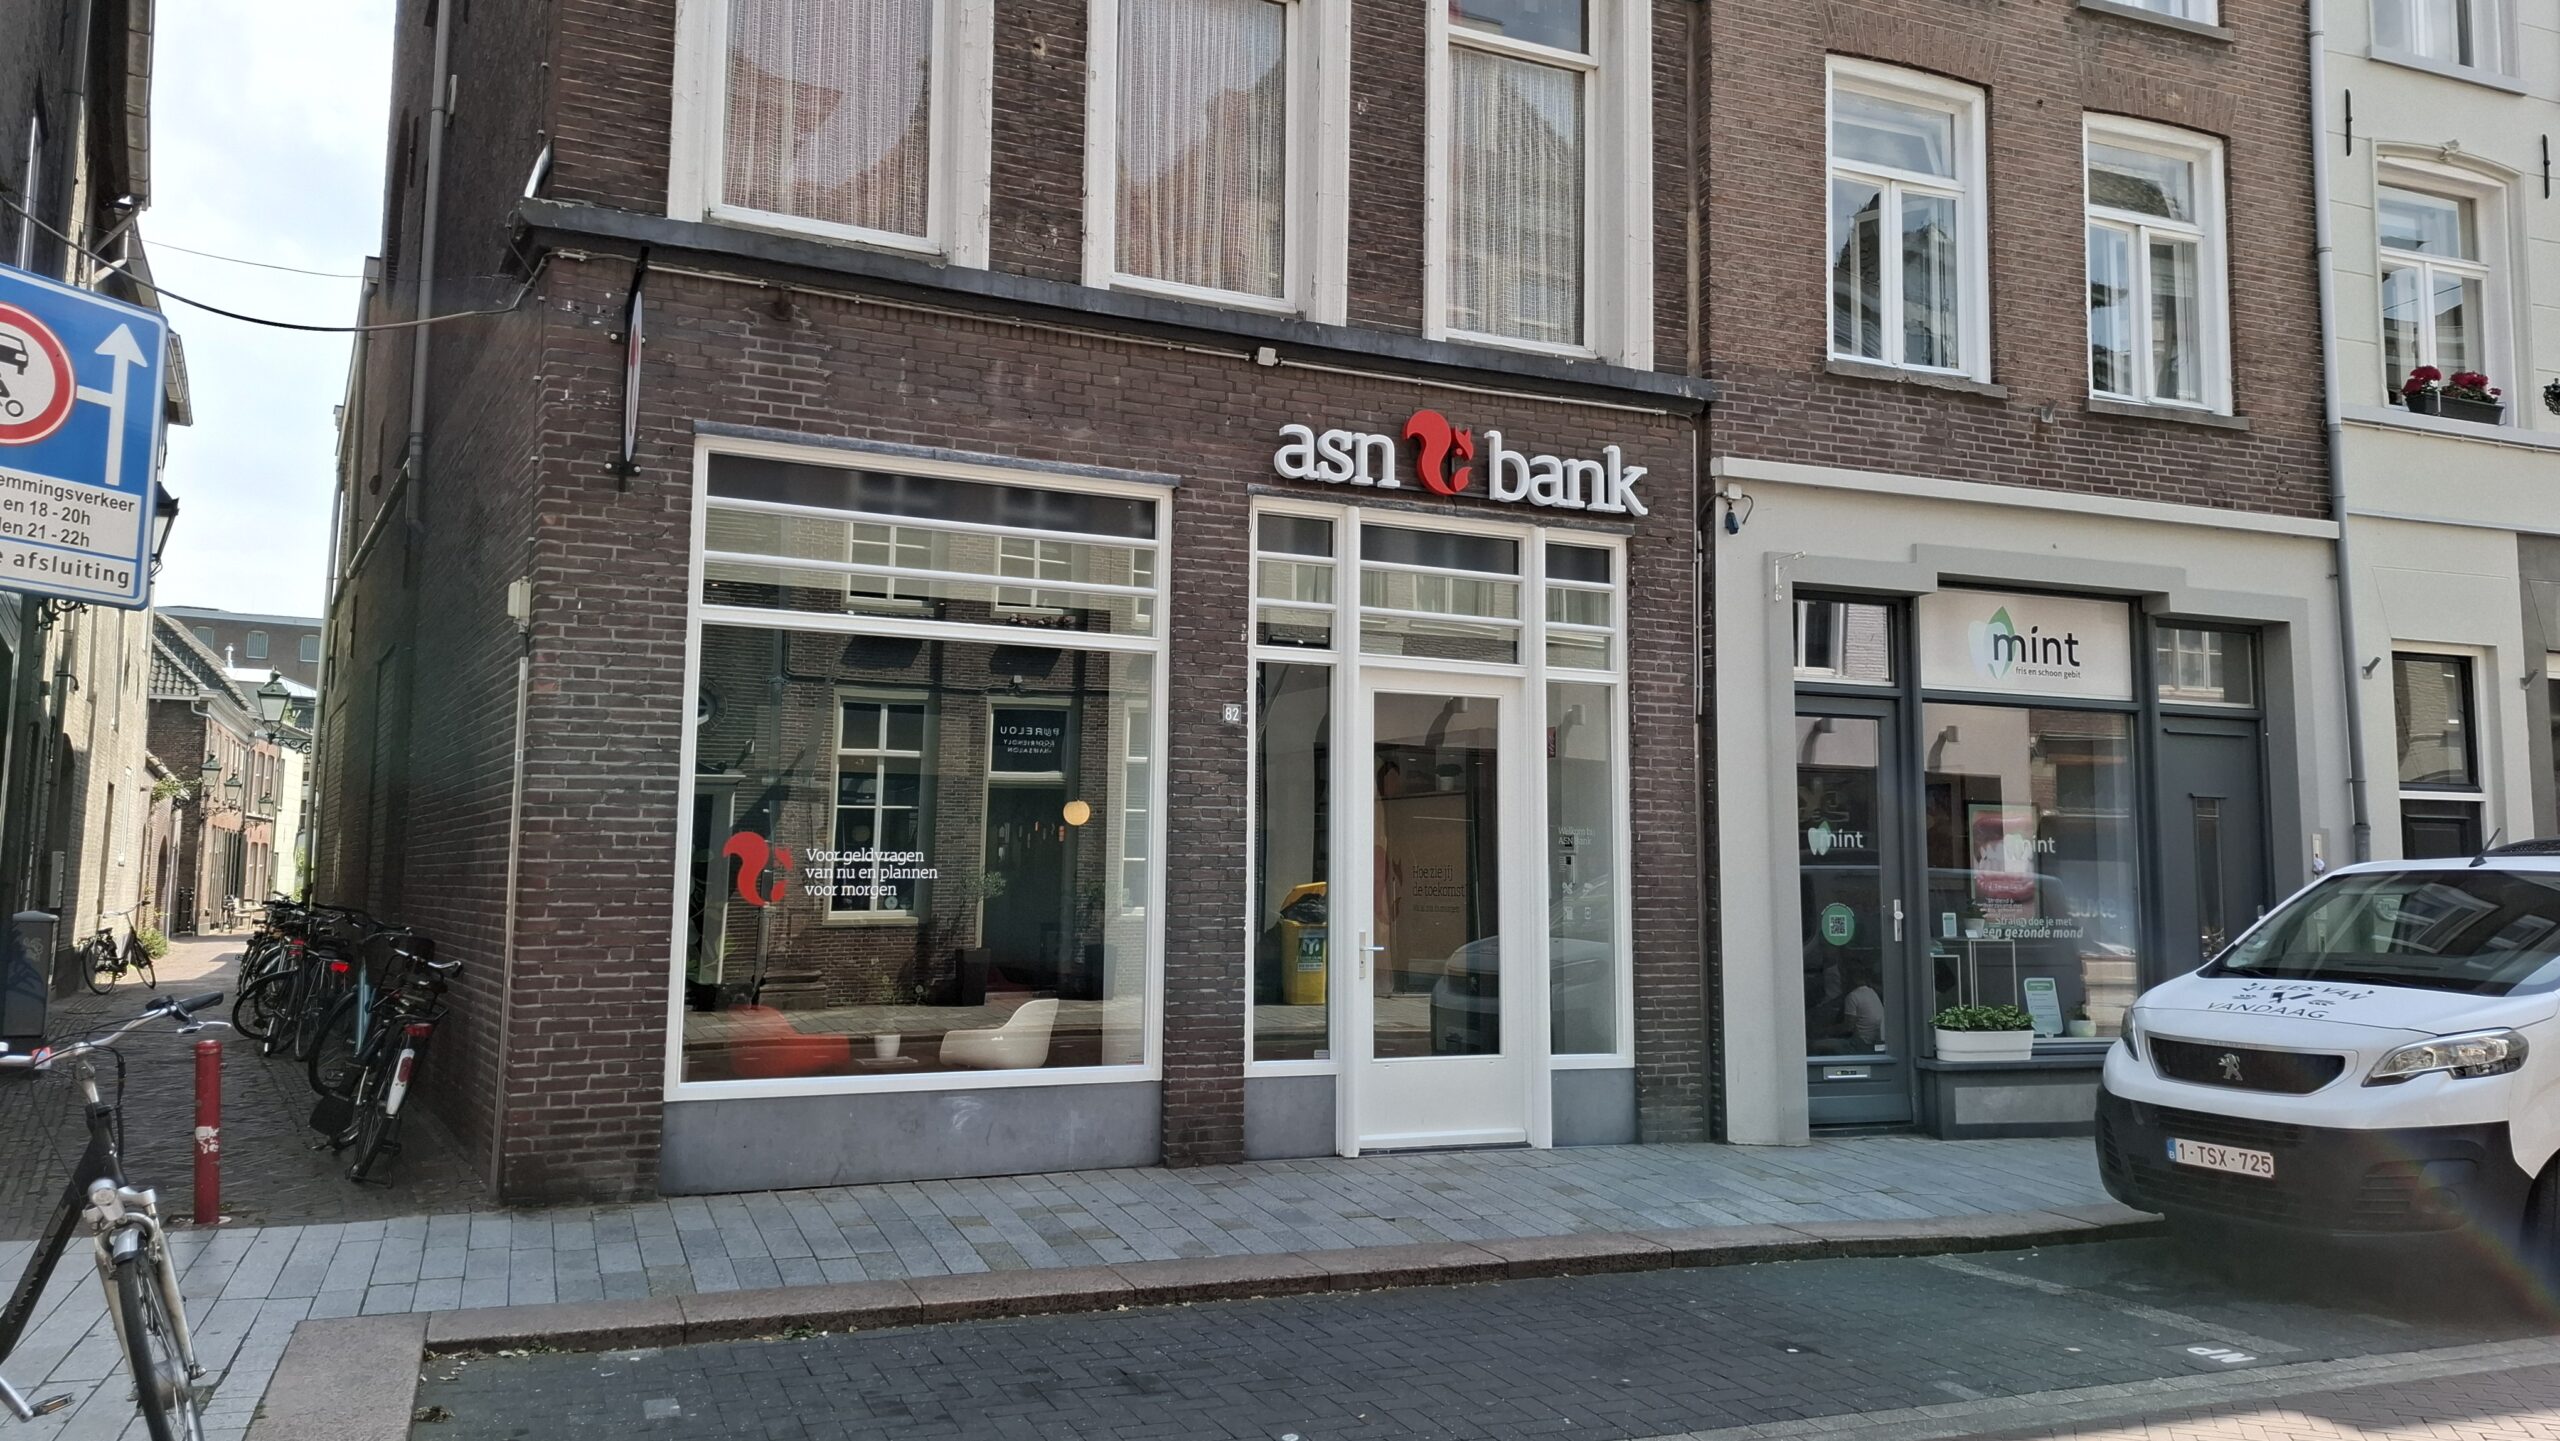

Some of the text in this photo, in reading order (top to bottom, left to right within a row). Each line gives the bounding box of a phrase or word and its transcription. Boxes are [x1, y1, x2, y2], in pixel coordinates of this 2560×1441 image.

[1273, 423, 1649, 517] asn bank
[3, 498, 24, 513] en
[29, 500, 48, 517] 18
[61, 506, 91, 526] 20h
[27, 522, 46, 539] 21
[60, 528, 90, 547] 22h
[13, 551, 129, 589] afsluiting
[1993, 625, 2081, 667] mint
[2015, 666, 2027, 675] fris
[2038, 669, 2062, 677] schoon
[2063, 670, 2081, 679] gebit
[1225, 707, 1240, 721] 82
[806, 847, 925, 866] Voor geldvragen
[805, 864, 938, 882] van nu en plannen
[1412, 865, 1428, 878] Hoe
[1430, 866, 1442, 878] zie
[804, 885, 898, 900] voor morgen
[1412, 881, 1465, 897] de toekomst
[2028, 916, 2045, 926] doe
[2045, 916, 2054, 928] je
[2055, 917, 2073, 926] met
[2004, 926, 2050, 941] gezonde
[2053, 926, 2084, 938] mond
[2208, 1002, 2329, 1019] VANDAAG
